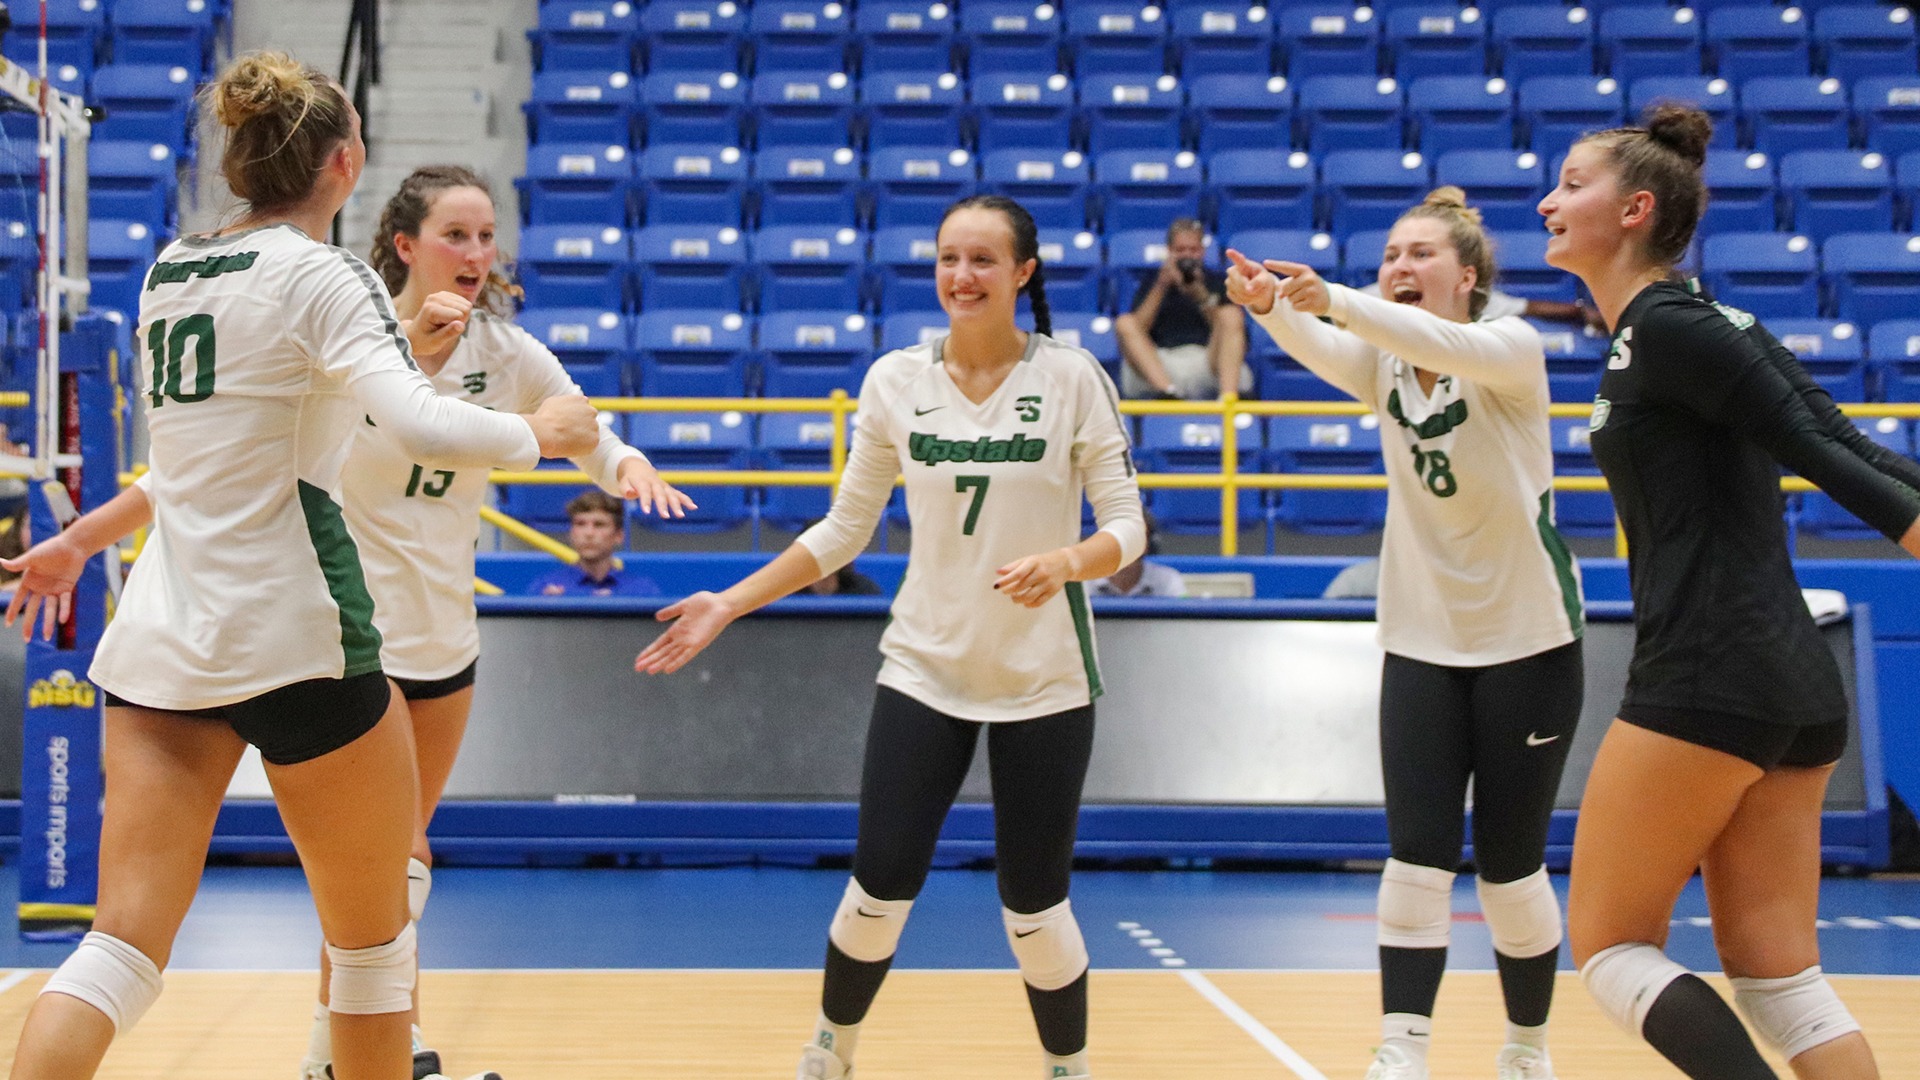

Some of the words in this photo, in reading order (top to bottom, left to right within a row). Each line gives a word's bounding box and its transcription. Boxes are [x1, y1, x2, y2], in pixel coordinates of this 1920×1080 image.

[148, 313, 216, 409] 10
[908, 431, 1047, 466] Upstate
[955, 475, 990, 536] 7
[47, 736, 70, 804] sports
[46, 805, 67, 889] imports
